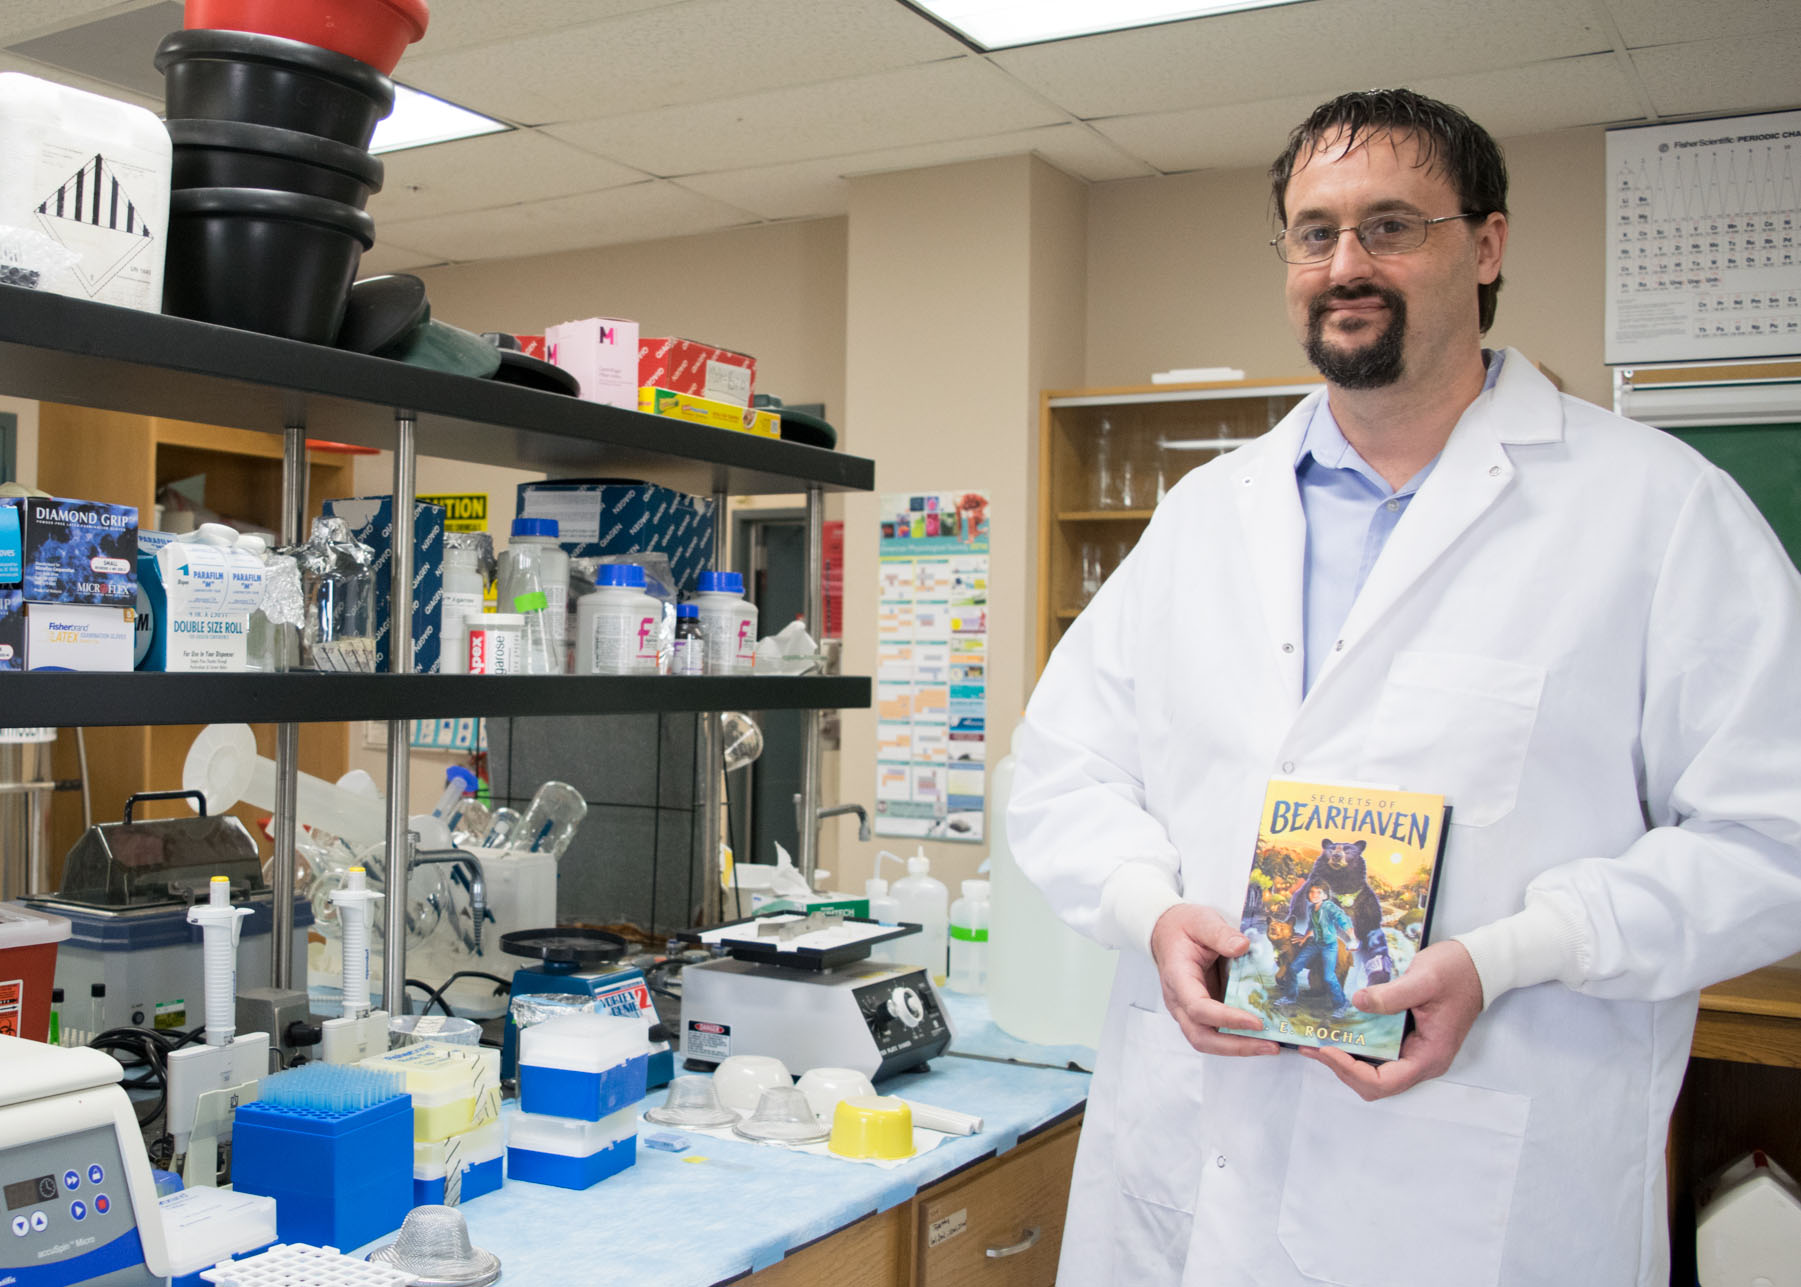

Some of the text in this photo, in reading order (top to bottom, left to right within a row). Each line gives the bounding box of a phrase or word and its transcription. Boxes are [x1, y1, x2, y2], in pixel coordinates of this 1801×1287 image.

[1736, 132, 1780, 143] PERIODIC
[1782, 129, 1801, 139] CHA
[644, 367, 665, 388] QIAGE
[434, 497, 484, 518] TION
[612, 489, 637, 514] QIAGEN
[35, 506, 129, 527] DIAMOND GRIP
[629, 511, 651, 536] QIAGEN
[421, 524, 441, 551] QIAGEN
[600, 522, 623, 547] QIAGEN
[0, 549, 16, 557] oves
[193, 570, 224, 580] PARAFILM
[232, 572, 262, 583] PARAFILM
[412, 561, 431, 590] QIAGEN
[77, 582, 130, 595] MICROFLEX
[48, 621, 90, 632] Fisherbrand
[50, 631, 80, 643] LATEX
[173, 620, 243, 634] DOUBLE SIZE ROLL
[494, 635, 506, 675] garose
[1310, 793, 1397, 809] SECRETS OF
[1269, 799, 1430, 850] BEARHAVEN
[634, 988, 653, 1009] 2
[1279, 1020, 1295, 1034] E.
[1304, 1024, 1367, 1047] ROCHA
[75, 1236, 96, 1248] Micro
